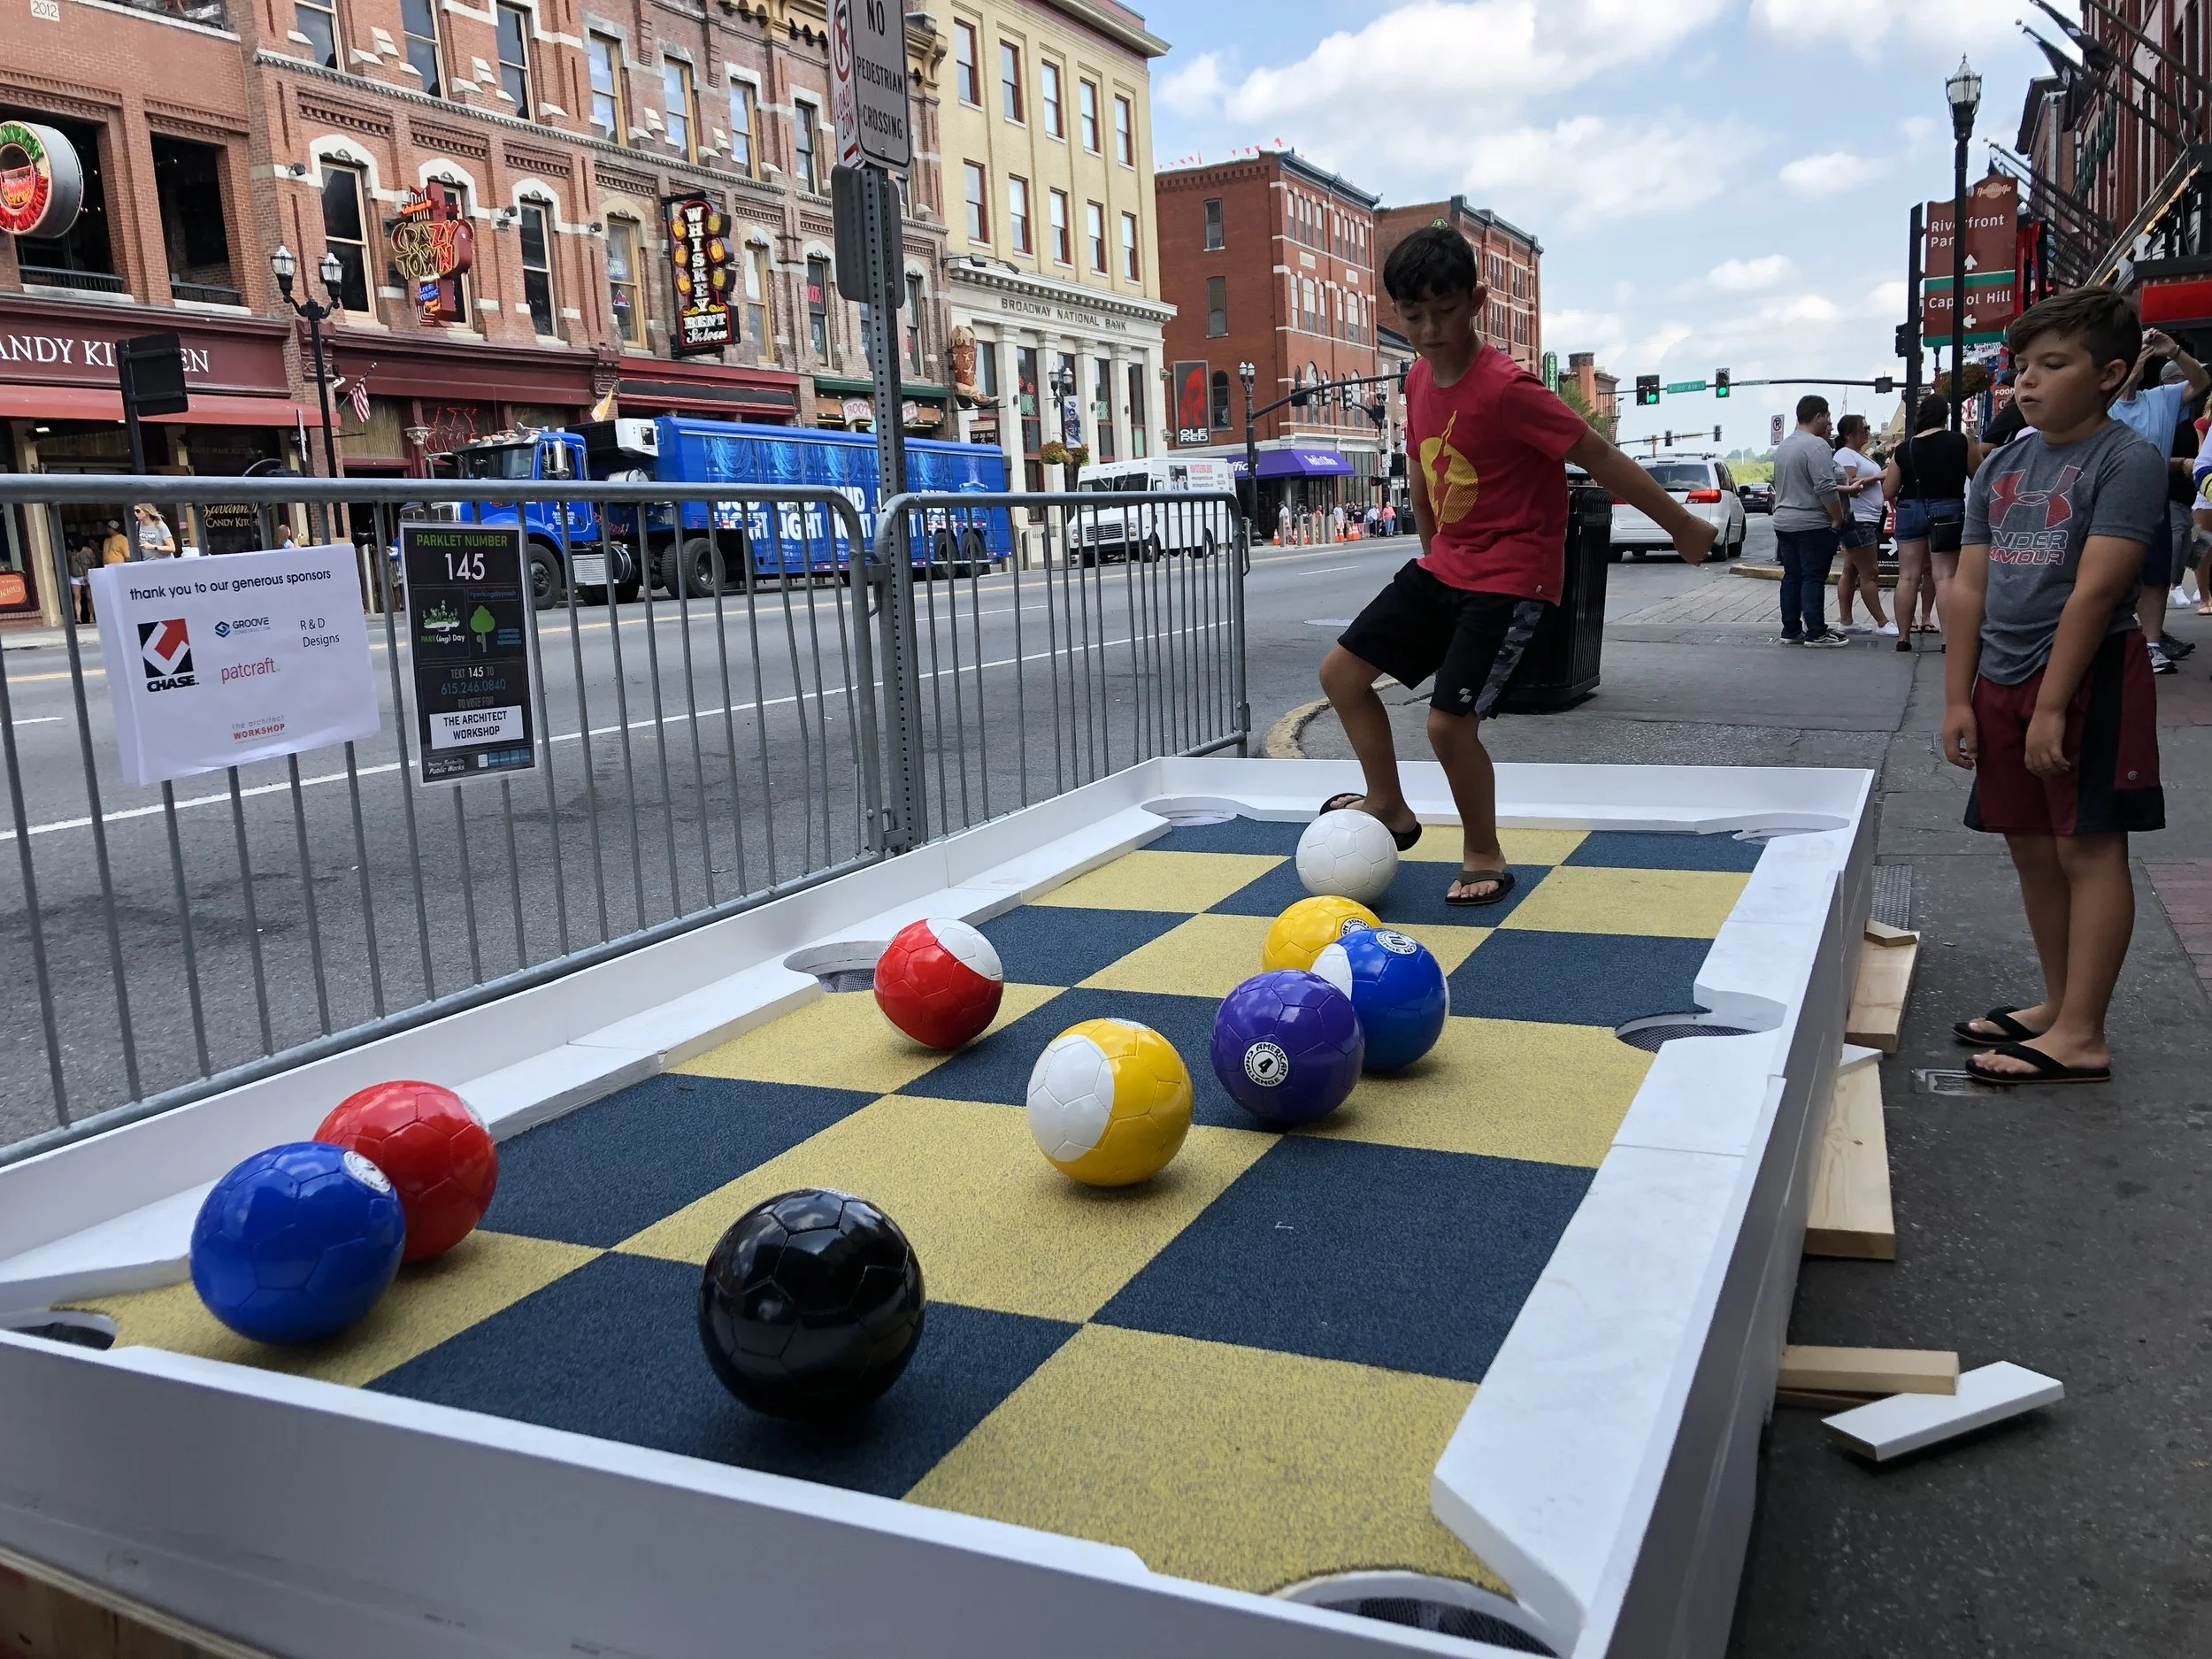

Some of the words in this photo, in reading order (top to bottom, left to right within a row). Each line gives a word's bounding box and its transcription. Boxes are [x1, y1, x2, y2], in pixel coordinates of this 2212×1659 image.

[33, 1, 58, 18] 2012
[866, 0, 885, 35] NO
[856, 56, 903, 95] PEDESTRIAN
[842, 108, 855, 140] ZON
[863, 104, 902, 140] CROSSING
[1932, 214, 2005, 233] Rivfront
[391, 219, 458, 253] CRAZY
[1931, 236, 1955, 248] Par
[396, 244, 453, 280] TOWN
[685, 206, 709, 312] WHISKEY
[1929, 294, 1979, 310] Capol
[1986, 290, 2011, 303] Hill
[1002, 298, 1051, 318] BROADWAY
[1057, 309, 1100, 326] NATIONAL
[1105, 318, 1126, 331] BANK
[81, 340, 210, 373] KIEN
[204, 503, 261, 518] Savannh
[416, 534, 462, 546] PARKLET
[465, 535, 508, 547] NUMBER
[1991, 530, 2069, 549] NDER
[444, 552, 486, 580] 145
[130, 586, 166, 600] thank
[169, 584, 192, 598] you
[195, 581, 207, 593] to
[210, 580, 229, 591] our
[232, 574, 284, 592] generous
[286, 569, 331, 585] sponsors
[233, 617, 270, 629] GROOVE
[300, 620, 307, 630] R
[309, 619, 316, 629] &
[318, 618, 326, 627] D
[303, 634, 340, 647] Designs
[221, 657, 276, 684] patcraft
[450, 668, 465, 679] TEXT
[468, 666, 484, 678] 145
[487, 666, 495, 676] TO
[441, 680, 506, 695] 615.246.0840
[443, 716, 460, 726] THE
[462, 710, 508, 725] ARCHITECT
[234, 723, 285, 740] WORKSHOP
[453, 726, 500, 740] WORKSHOP
[428, 766, 447, 775] Public
[1388, 936, 1407, 946] 10
[1246, 1050, 1280, 1086] CHALLENGE
[1256, 1043, 1286, 1076] AMERICAN
[1258, 1058, 1274, 1074] 4
